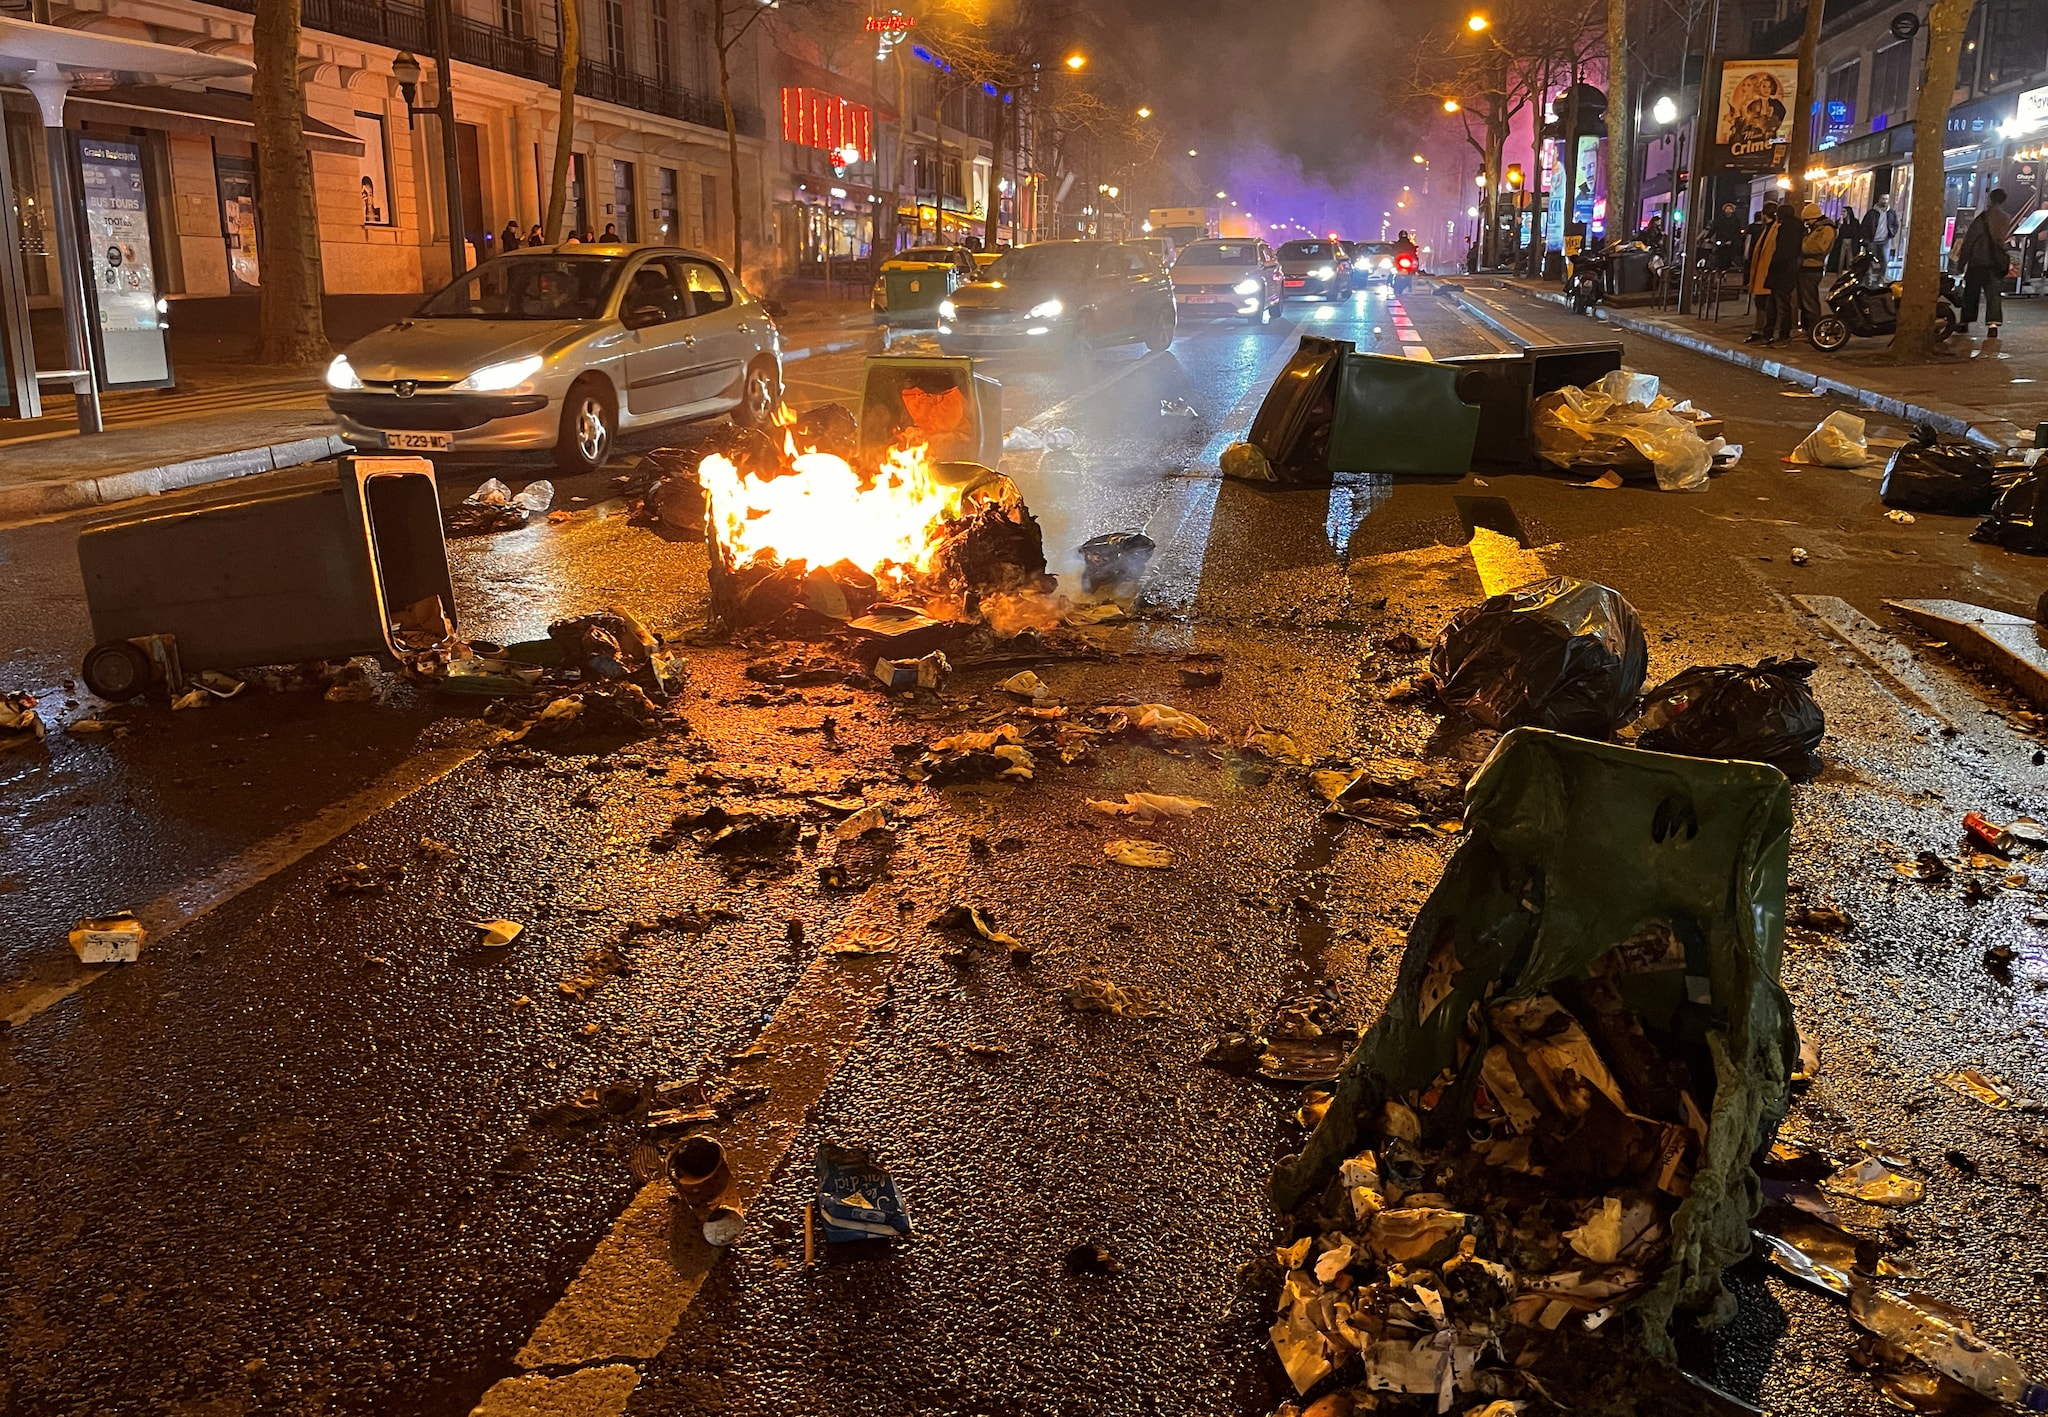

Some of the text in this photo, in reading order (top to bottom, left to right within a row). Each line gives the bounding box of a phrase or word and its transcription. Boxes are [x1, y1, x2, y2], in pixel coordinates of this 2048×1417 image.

[84, 147, 137, 161] Grands Boulevards
[1731, 140, 1773, 156] Crime
[91, 197, 139, 210] BUS TOURS
